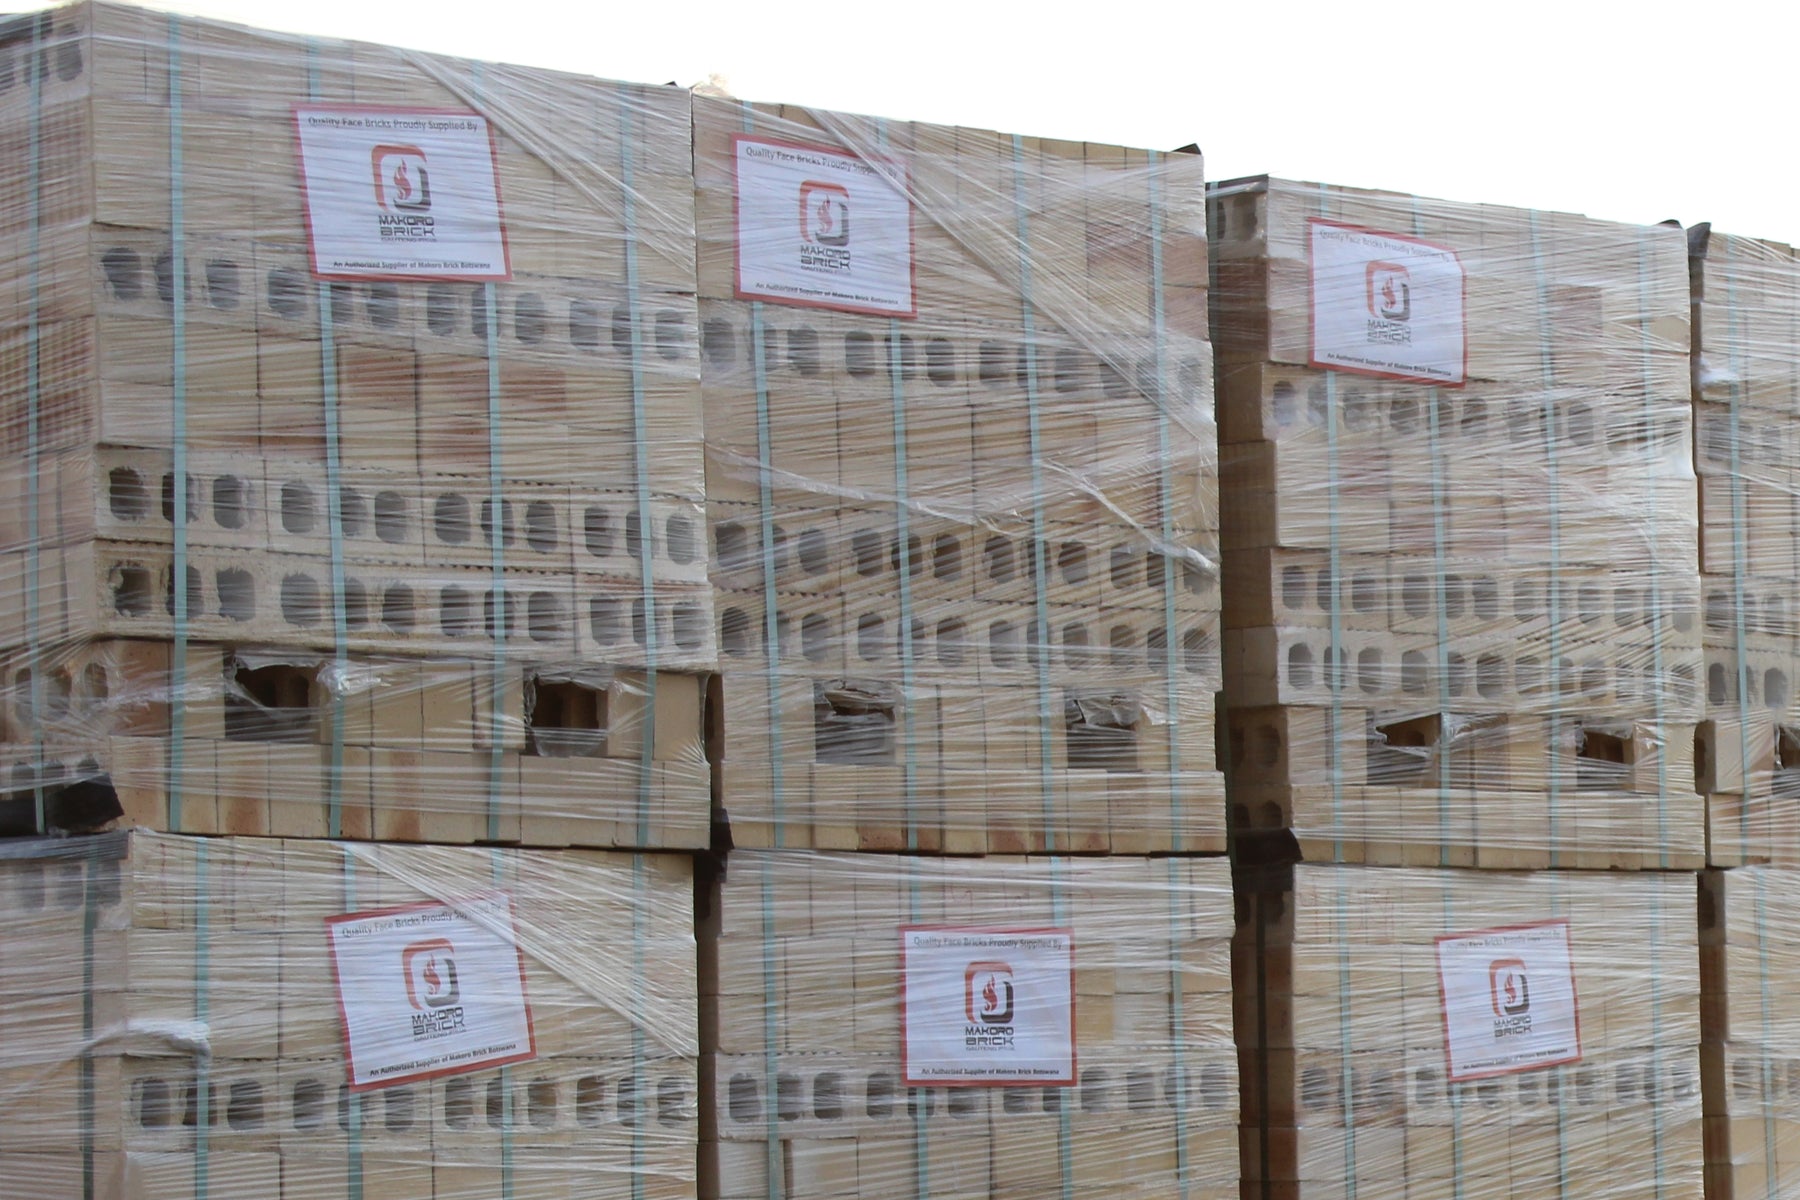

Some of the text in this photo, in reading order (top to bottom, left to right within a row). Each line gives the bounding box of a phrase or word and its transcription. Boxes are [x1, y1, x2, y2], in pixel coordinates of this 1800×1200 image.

[308, 117, 340, 127] Quality
[365, 119, 391, 128] Bricks
[394, 119, 426, 130] Proudly
[429, 120, 464, 131] Supplied
[467, 121, 478, 132] By
[746, 146, 775, 160] Quality
[776, 152, 794, 162] Face
[797, 153, 820, 165] Bricks
[822, 157, 851, 172] Proudly
[379, 215, 434, 226] MAKORO
[380, 226, 435, 236] BRICK
[801, 245, 850, 260] MAKORO
[1362, 237, 1383, 248] Bricks
[1384, 239, 1410, 254] Proudly
[801, 255, 851, 270] BRICK
[799, 288, 823, 297] Supplier
[832, 291, 854, 299] Makoro
[855, 294, 869, 302] Brick
[870, 296, 899, 305] Botswana
[342, 923, 372, 938] Quality
[375, 921, 394, 932] Face
[395, 917, 420, 929] Bricks
[421, 911, 452, 924] Proudly
[914, 936, 941, 947] Quality
[963, 937, 987, 947] Bricks
[989, 938, 1017, 949] Proudly
[411, 1006, 464, 1025] MAKORO
[1494, 1015, 1532, 1028] MAKORO
[413, 1016, 465, 1036] BRICK
[965, 1026, 1014, 1036] MAKORO
[1494, 1025, 1532, 1038] BRICK
[965, 1036, 1014, 1046] BRICK
[370, 1043, 516, 1077] An Authorized Supplier of Makoro Brick Botswana
[964, 1068, 987, 1076] Supplier
